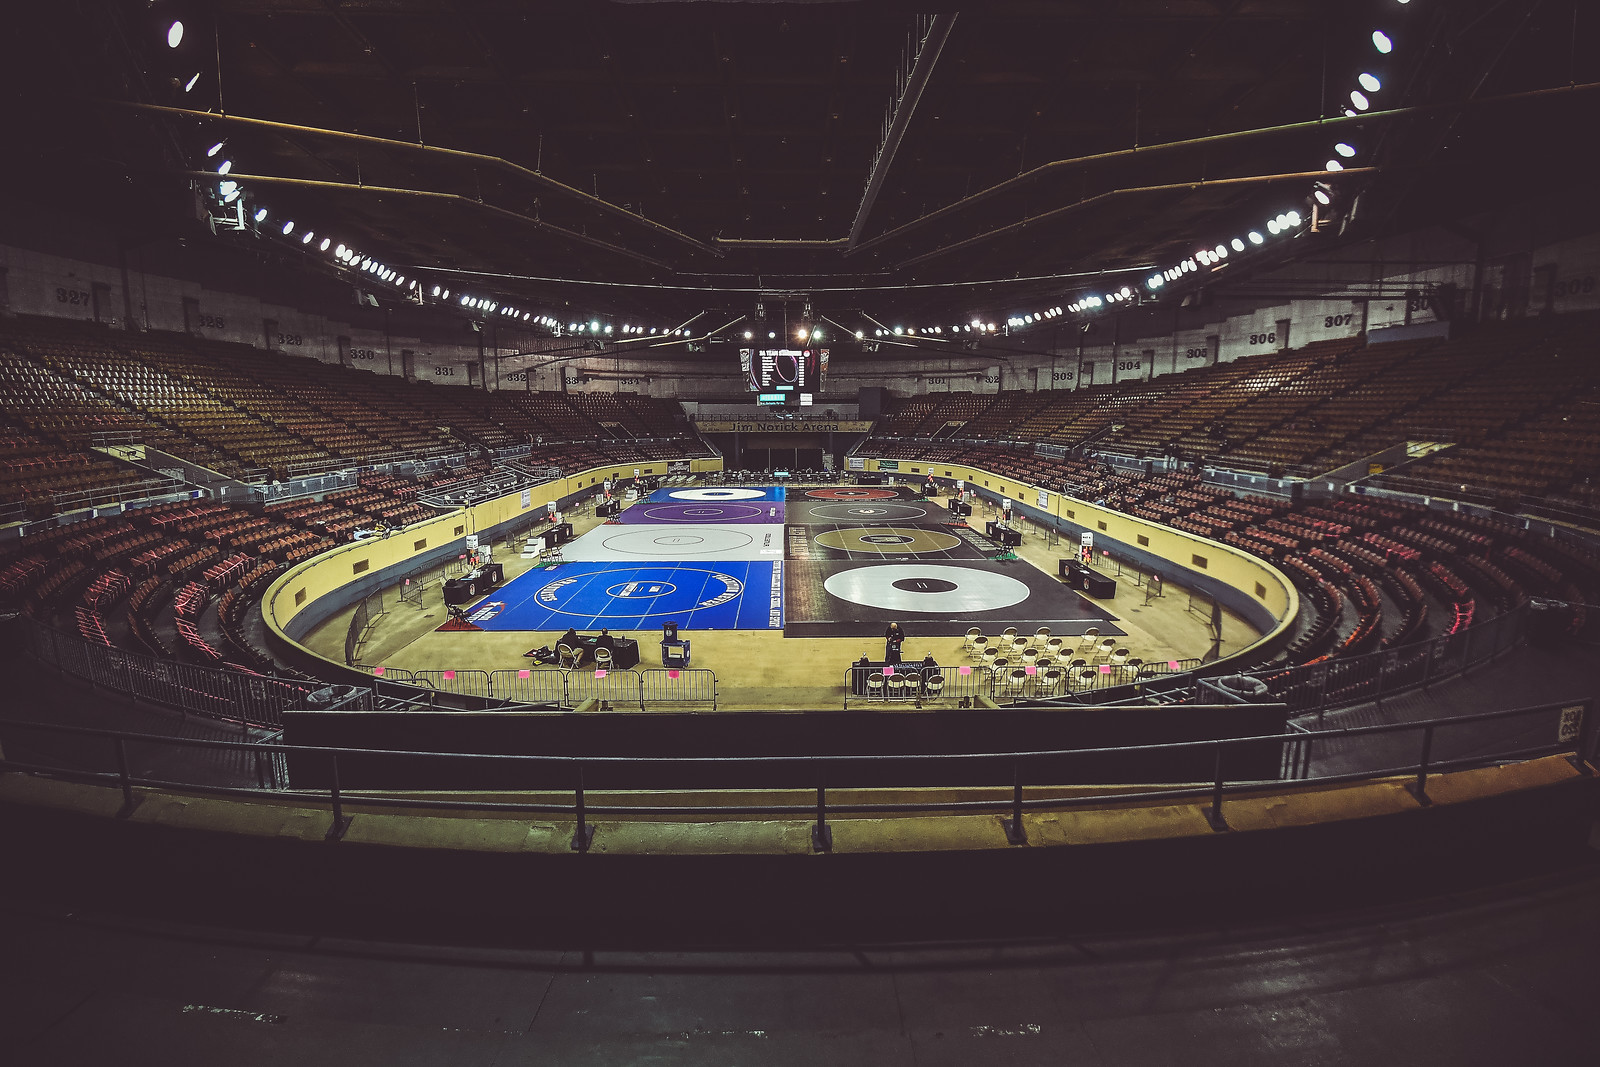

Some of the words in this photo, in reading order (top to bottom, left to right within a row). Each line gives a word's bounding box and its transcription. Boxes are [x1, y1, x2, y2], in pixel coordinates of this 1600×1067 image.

[56, 287, 90, 306] 327
[1324, 314, 1353, 328] 307
[277, 332, 303, 346] 329
[1249, 332, 1276, 345] 306
[350, 348, 375, 360] 330
[1187, 348, 1208, 359] 305
[435, 366, 455, 376] 331
[1118, 361, 1141, 371] 304
[507, 373, 527, 382] 332
[1053, 372, 1074, 381] 303
[729, 422, 753, 431] Jim
[757, 422, 798, 431] Norick
[802, 422, 839, 431] Arena
